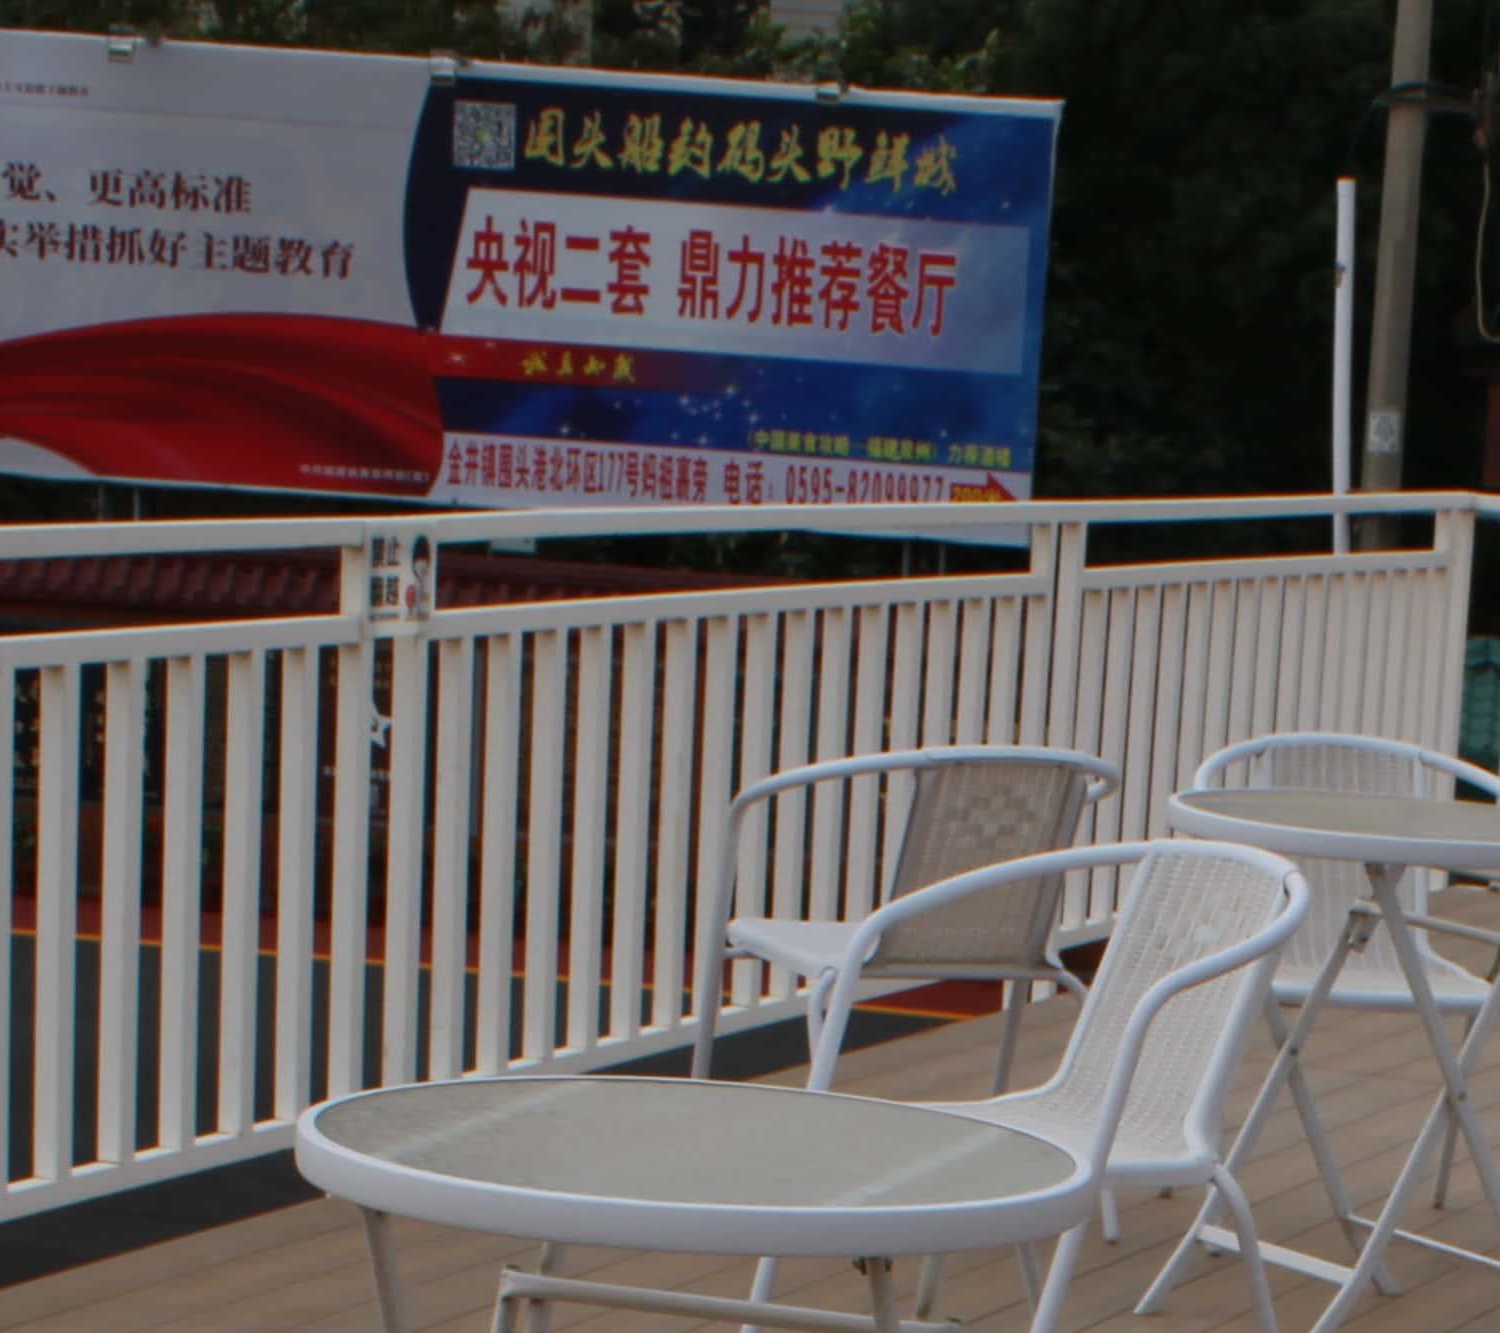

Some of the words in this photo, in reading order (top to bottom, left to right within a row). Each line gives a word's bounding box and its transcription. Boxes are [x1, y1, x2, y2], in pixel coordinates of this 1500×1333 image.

[465, 213, 652, 317] 央视二套
[676, 229, 958, 338] 鼎力推荐餐厅
